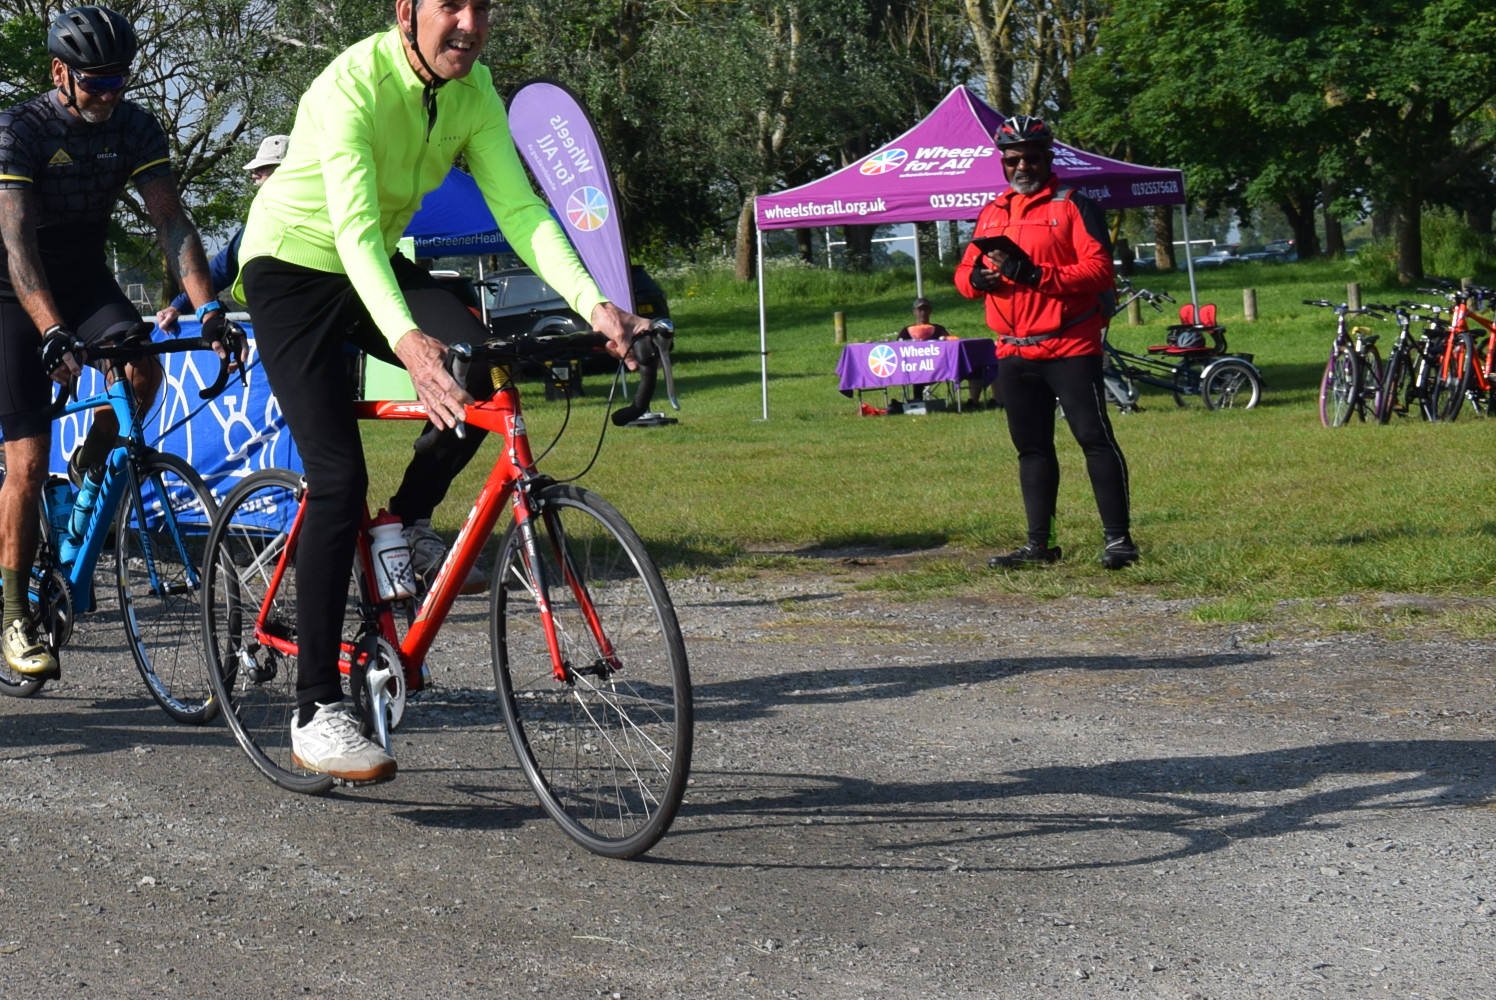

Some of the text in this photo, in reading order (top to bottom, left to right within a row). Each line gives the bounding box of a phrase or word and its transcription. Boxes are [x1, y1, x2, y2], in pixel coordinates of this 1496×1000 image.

[914, 145, 995, 160] Wheels
[904, 158, 974, 172] for All
[765, 198, 886, 219] wheelsforall.org.uk
[900, 344, 940, 358] Wheels
[901, 359, 934, 372] for All
